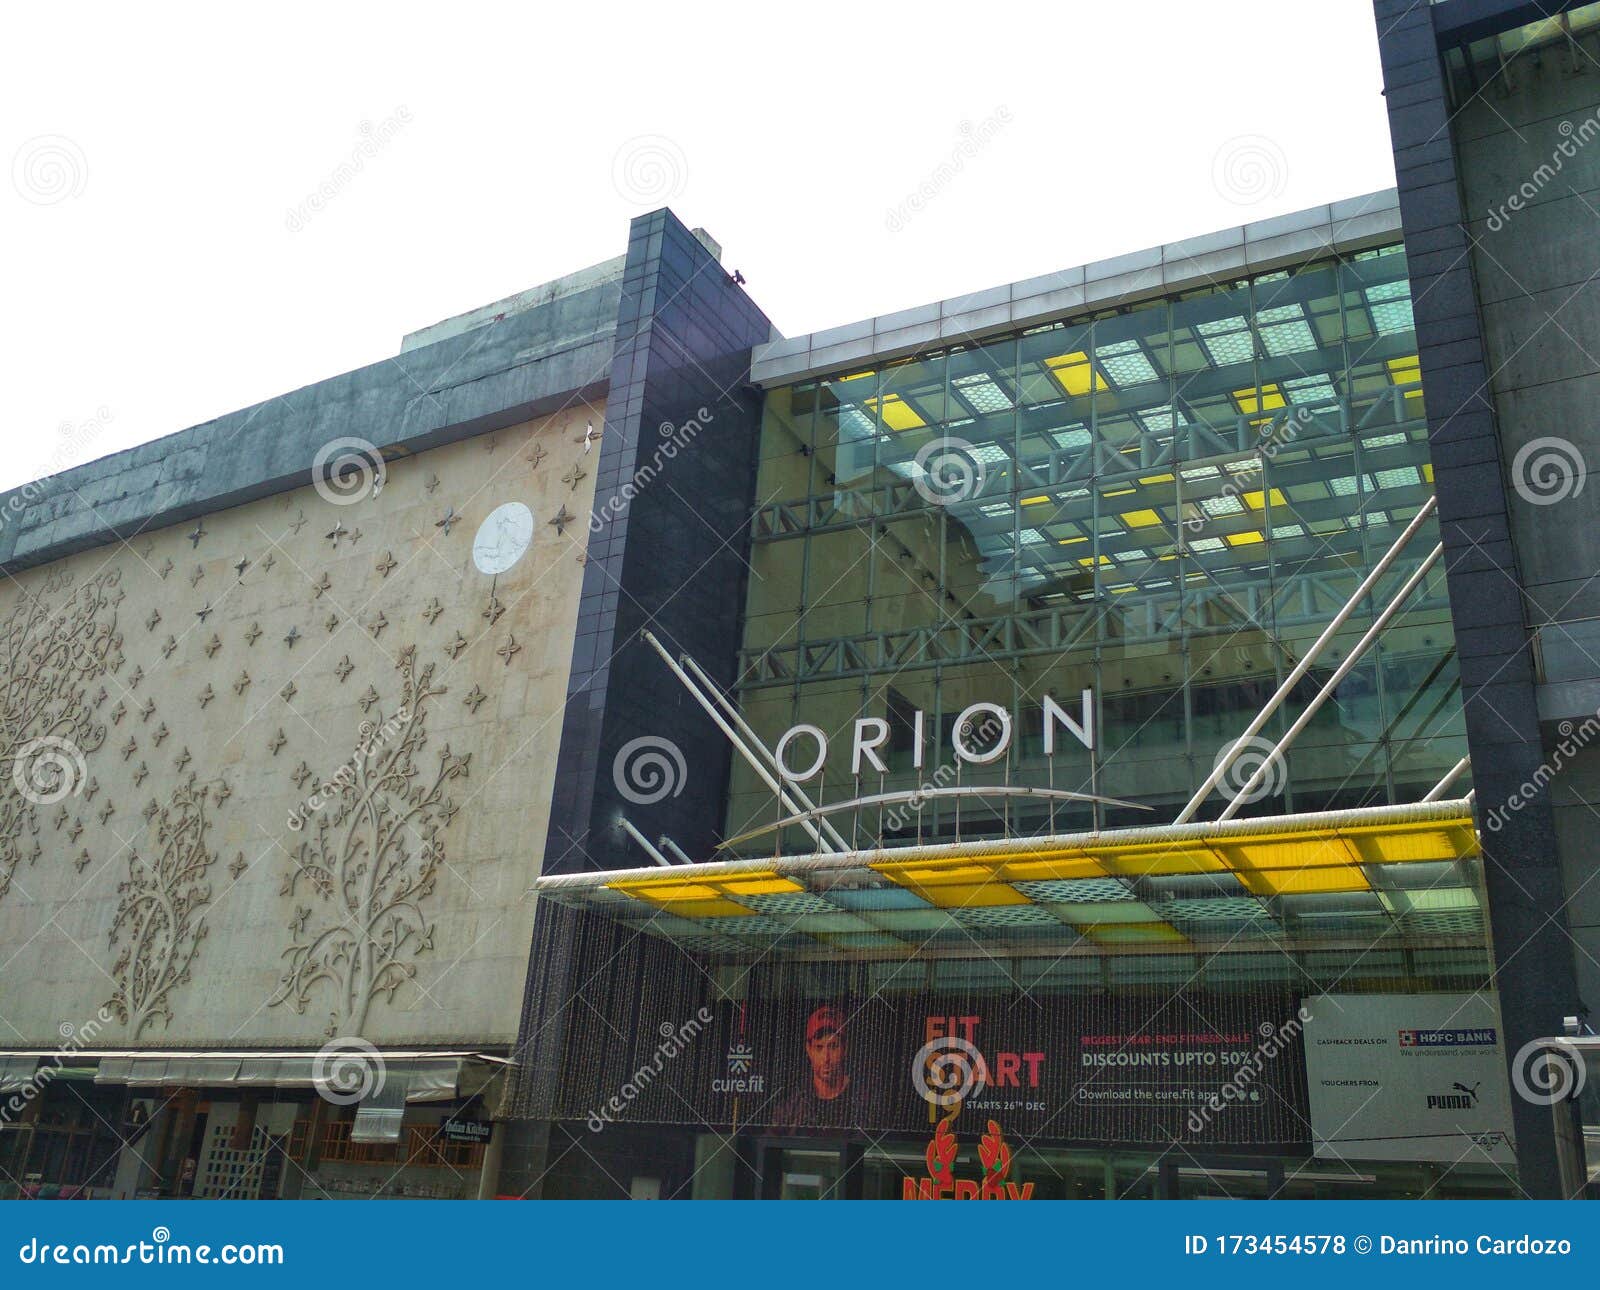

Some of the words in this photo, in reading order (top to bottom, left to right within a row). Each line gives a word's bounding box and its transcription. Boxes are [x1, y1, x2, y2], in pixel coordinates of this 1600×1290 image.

[775, 689, 1095, 783] ORION
[926, 1016, 980, 1050] FIT
[1224, 1033, 1251, 1044] SALE
[1419, 1033, 1453, 1043] HDFC
[1456, 1032, 1493, 1042] BANK
[1082, 1052, 1170, 1067] DISCOUNTS
[1173, 1052, 1216, 1066] UPTO
[1220, 1051, 1252, 1066] 50%
[925, 1052, 1045, 1088] START
[711, 1075, 764, 1094] cure.fit
[1079, 1088, 1131, 1100] Download
[1134, 1088, 1152, 1099] the
[1155, 1088, 1195, 1100] cure.fit
[966, 1101, 1001, 1111] STARTS
[1025, 1102, 1047, 1111] DEC
[1426, 1095, 1472, 1109] PUMA
